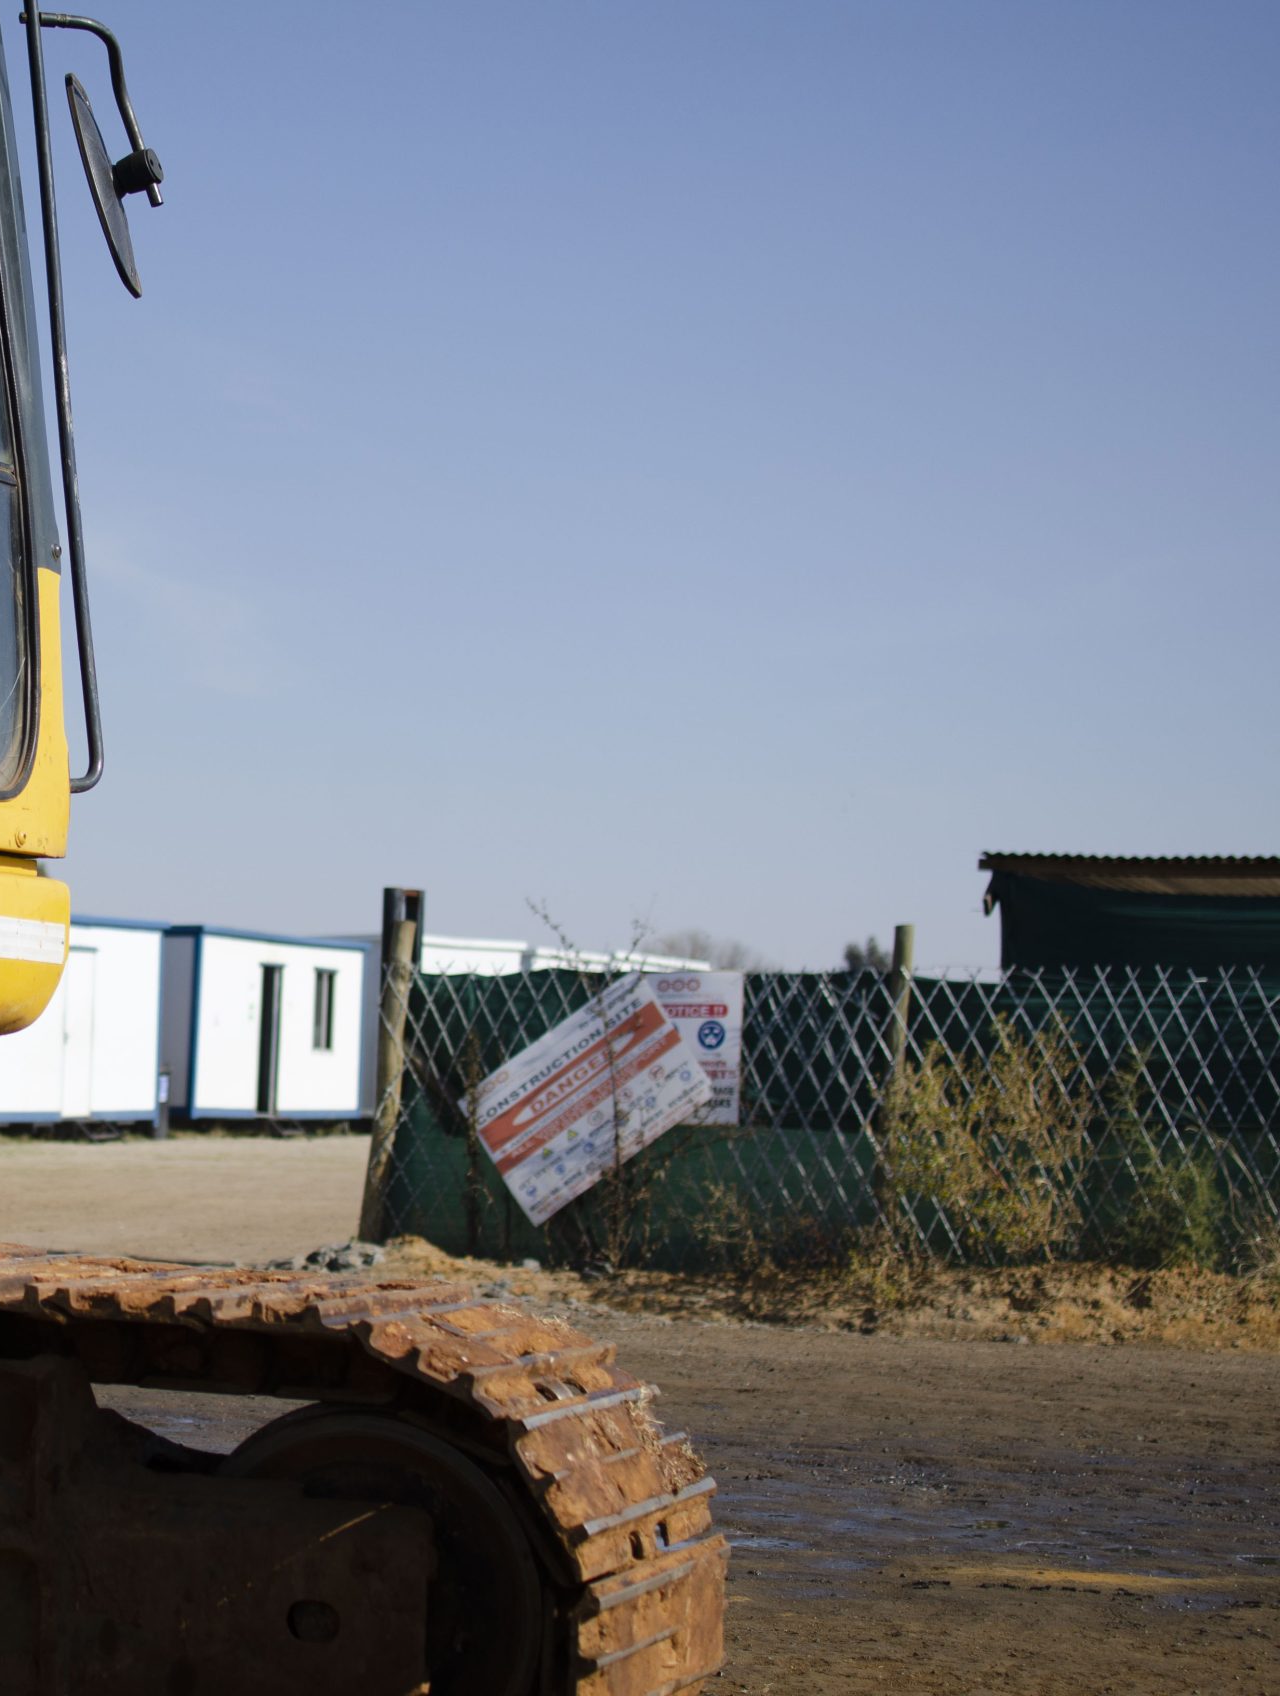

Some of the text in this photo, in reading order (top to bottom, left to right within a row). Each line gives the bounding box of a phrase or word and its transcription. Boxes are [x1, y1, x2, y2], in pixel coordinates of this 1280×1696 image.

[664, 1005, 709, 1017] OTICE
[474, 1027, 602, 1127] CONSTRUCTION
[603, 997, 643, 1030] SITE
